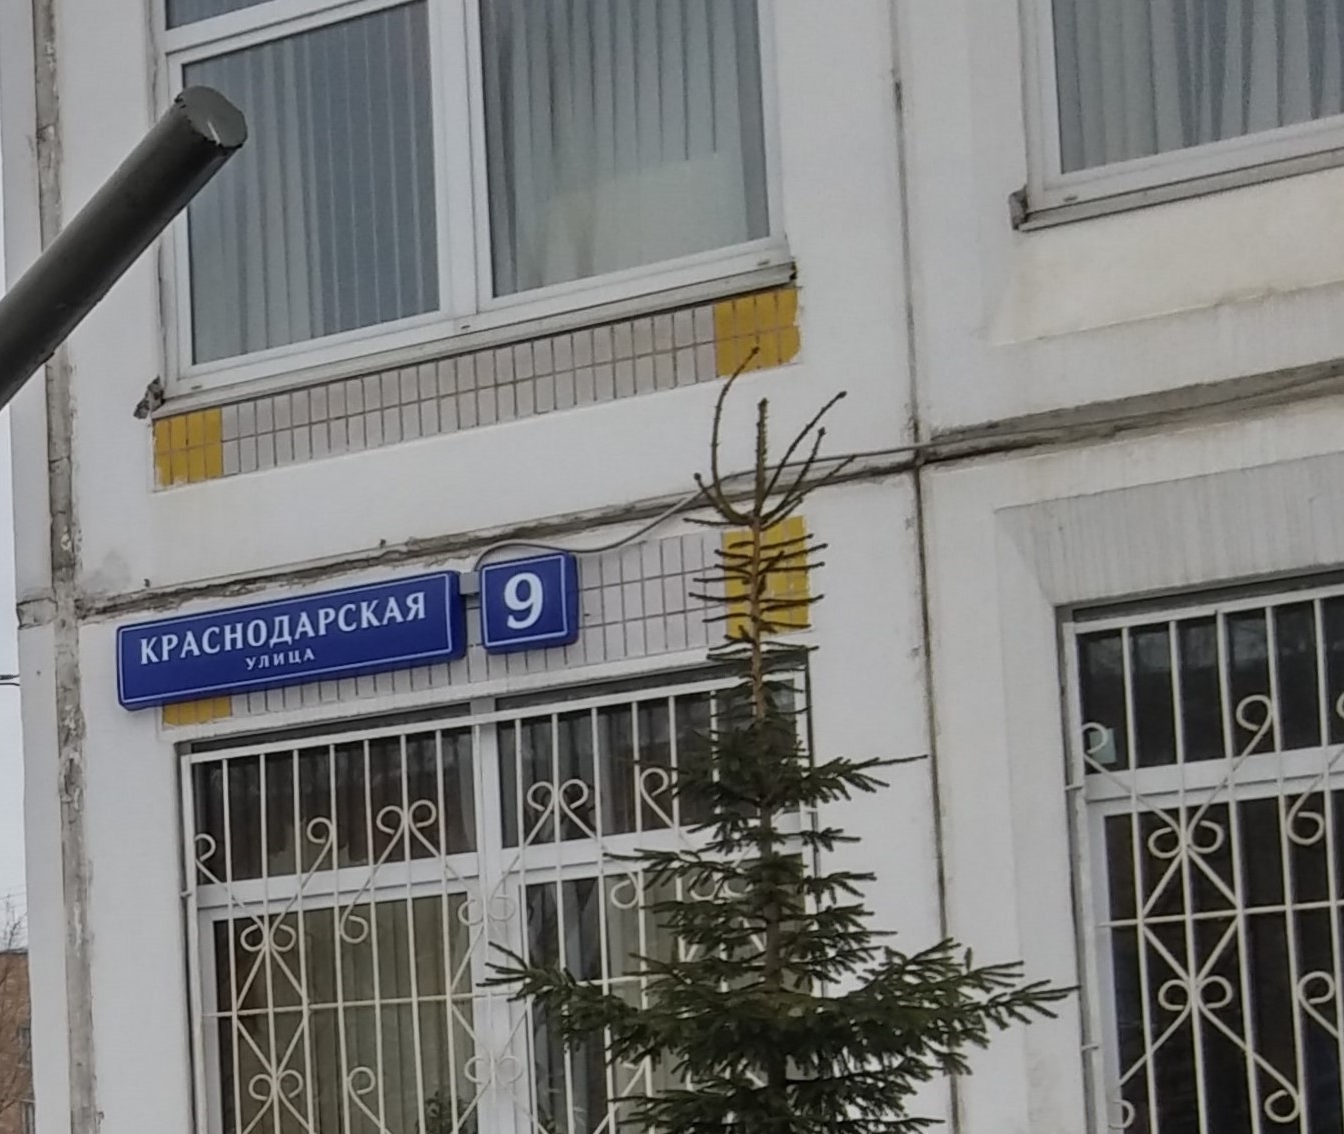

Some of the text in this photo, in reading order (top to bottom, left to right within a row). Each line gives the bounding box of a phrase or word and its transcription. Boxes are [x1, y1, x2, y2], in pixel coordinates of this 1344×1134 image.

[139, 591, 427, 665] КРАСНОДАРСКАЯ
[503, 571, 544, 630] 9
[245, 647, 316, 671] УЛИЦА
